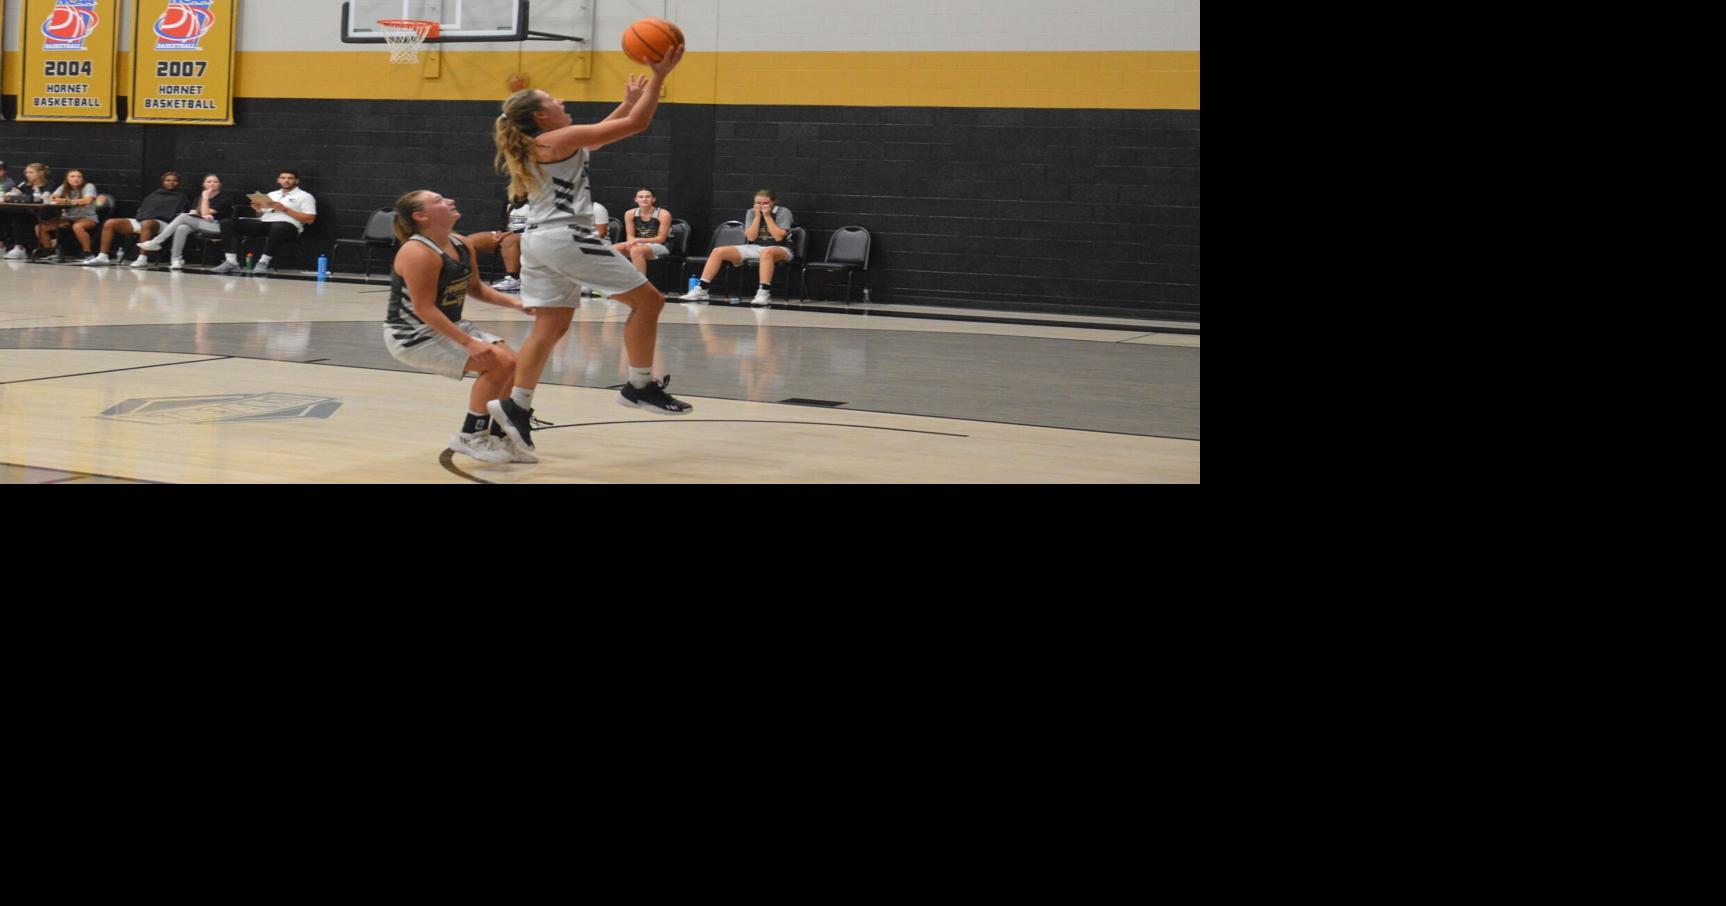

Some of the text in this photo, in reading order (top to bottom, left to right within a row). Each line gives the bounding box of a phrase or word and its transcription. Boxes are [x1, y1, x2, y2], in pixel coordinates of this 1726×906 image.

[44, 60, 92, 76] 2004
[156, 61, 207, 77] 2007
[46, 84, 88, 93] HORNET
[159, 85, 203, 95] HORNET
[33, 97, 100, 107] BASKETBALL
[144, 99, 216, 109] BASKETBALL
